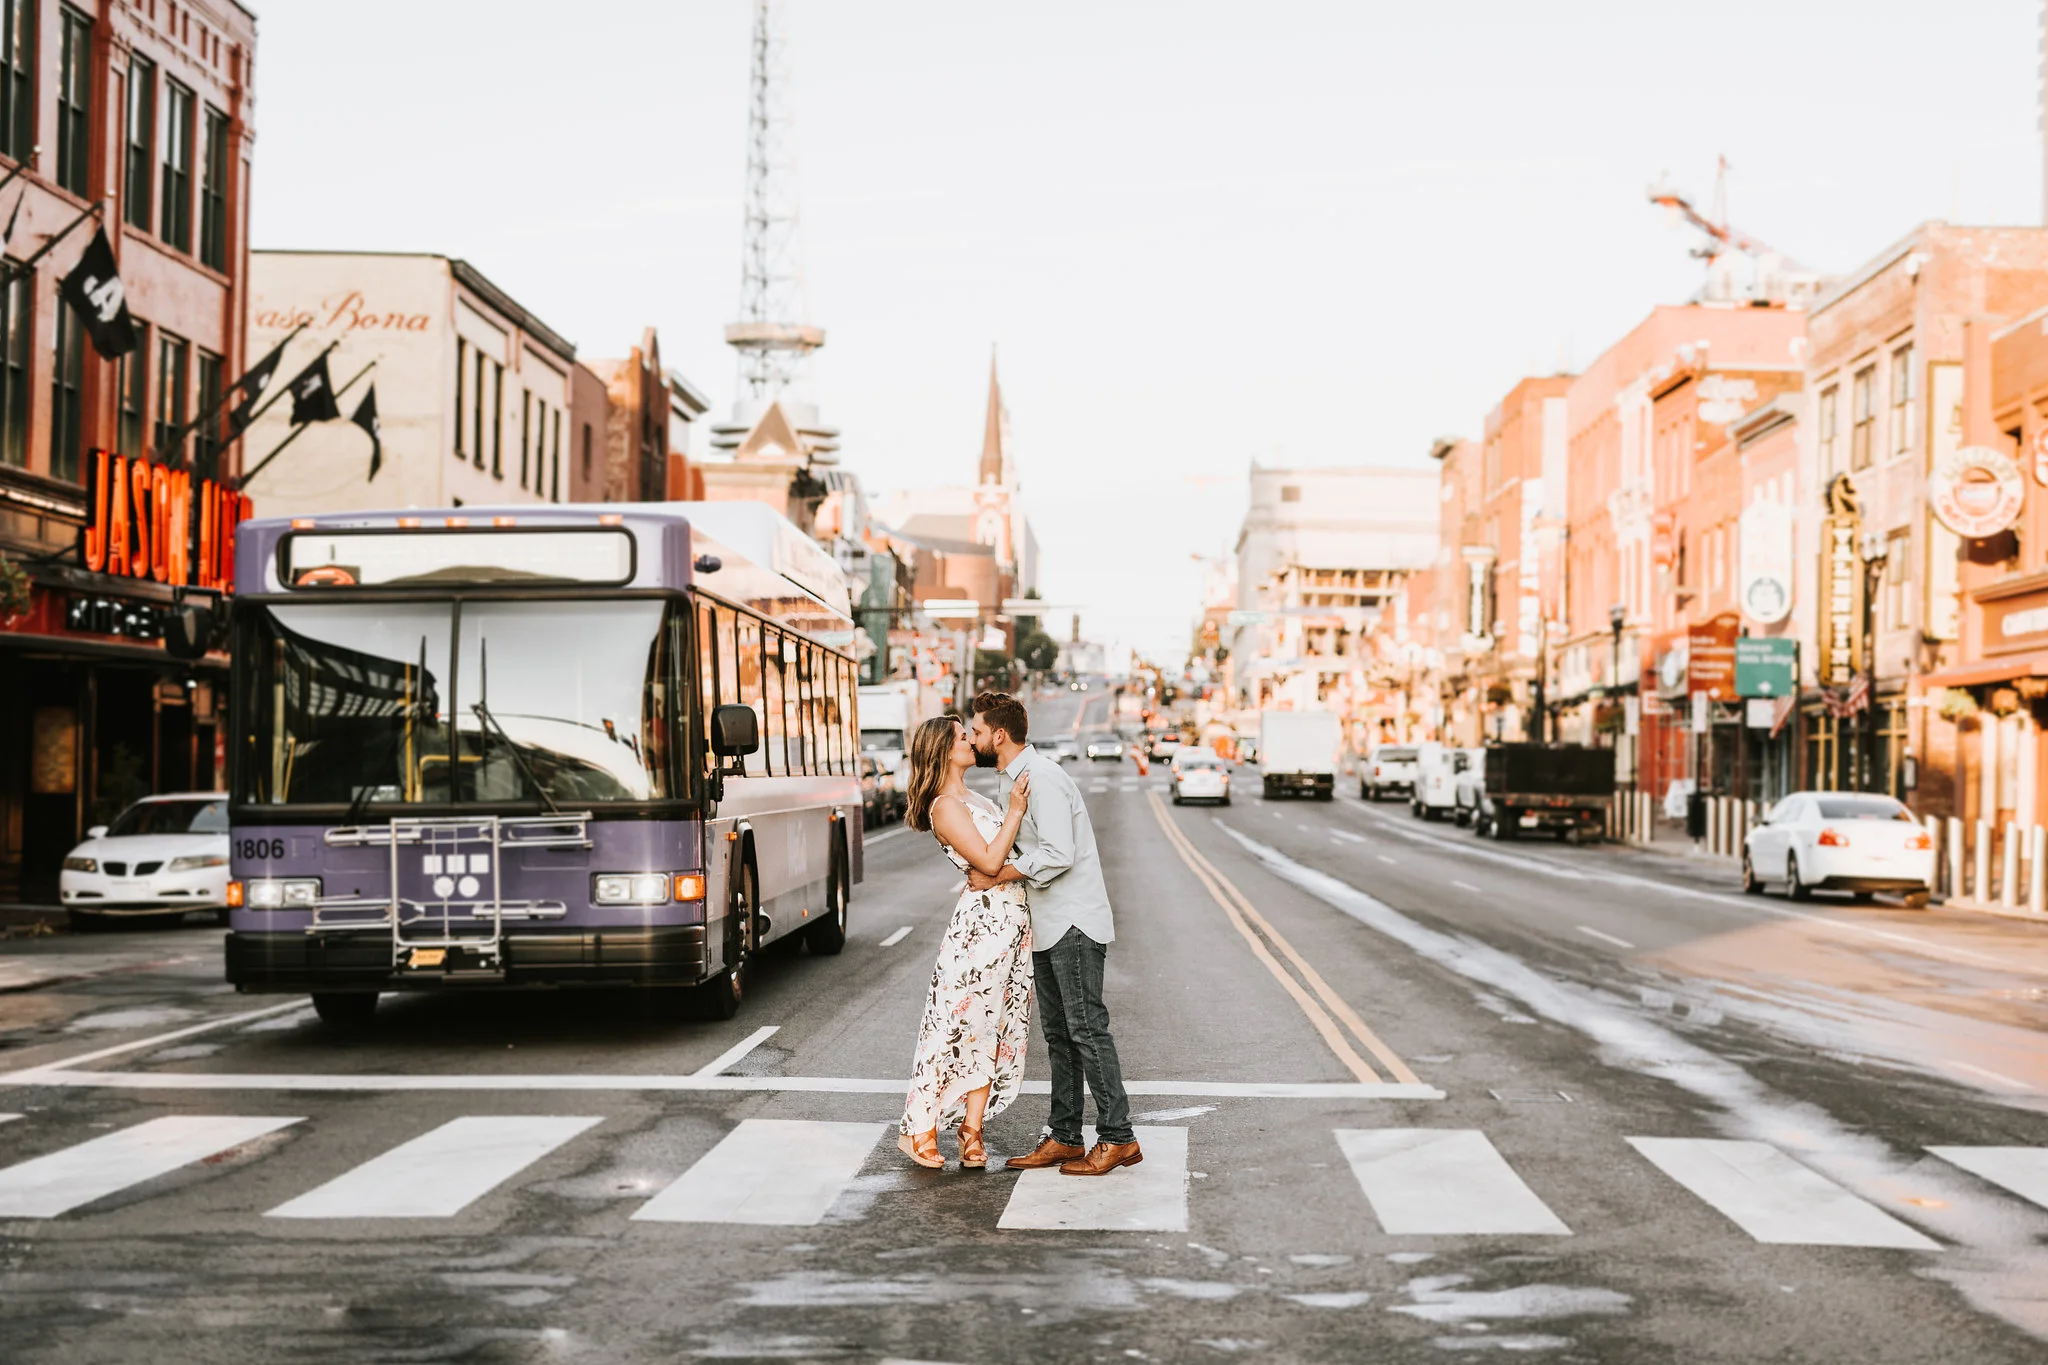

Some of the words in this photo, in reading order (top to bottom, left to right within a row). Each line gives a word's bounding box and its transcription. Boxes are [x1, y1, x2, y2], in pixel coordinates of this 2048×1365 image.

[320, 289, 432, 333] Bona
[85, 449, 191, 587] JASON
[71, 598, 166, 638] KITCE
[236, 838, 285, 860] 1806
